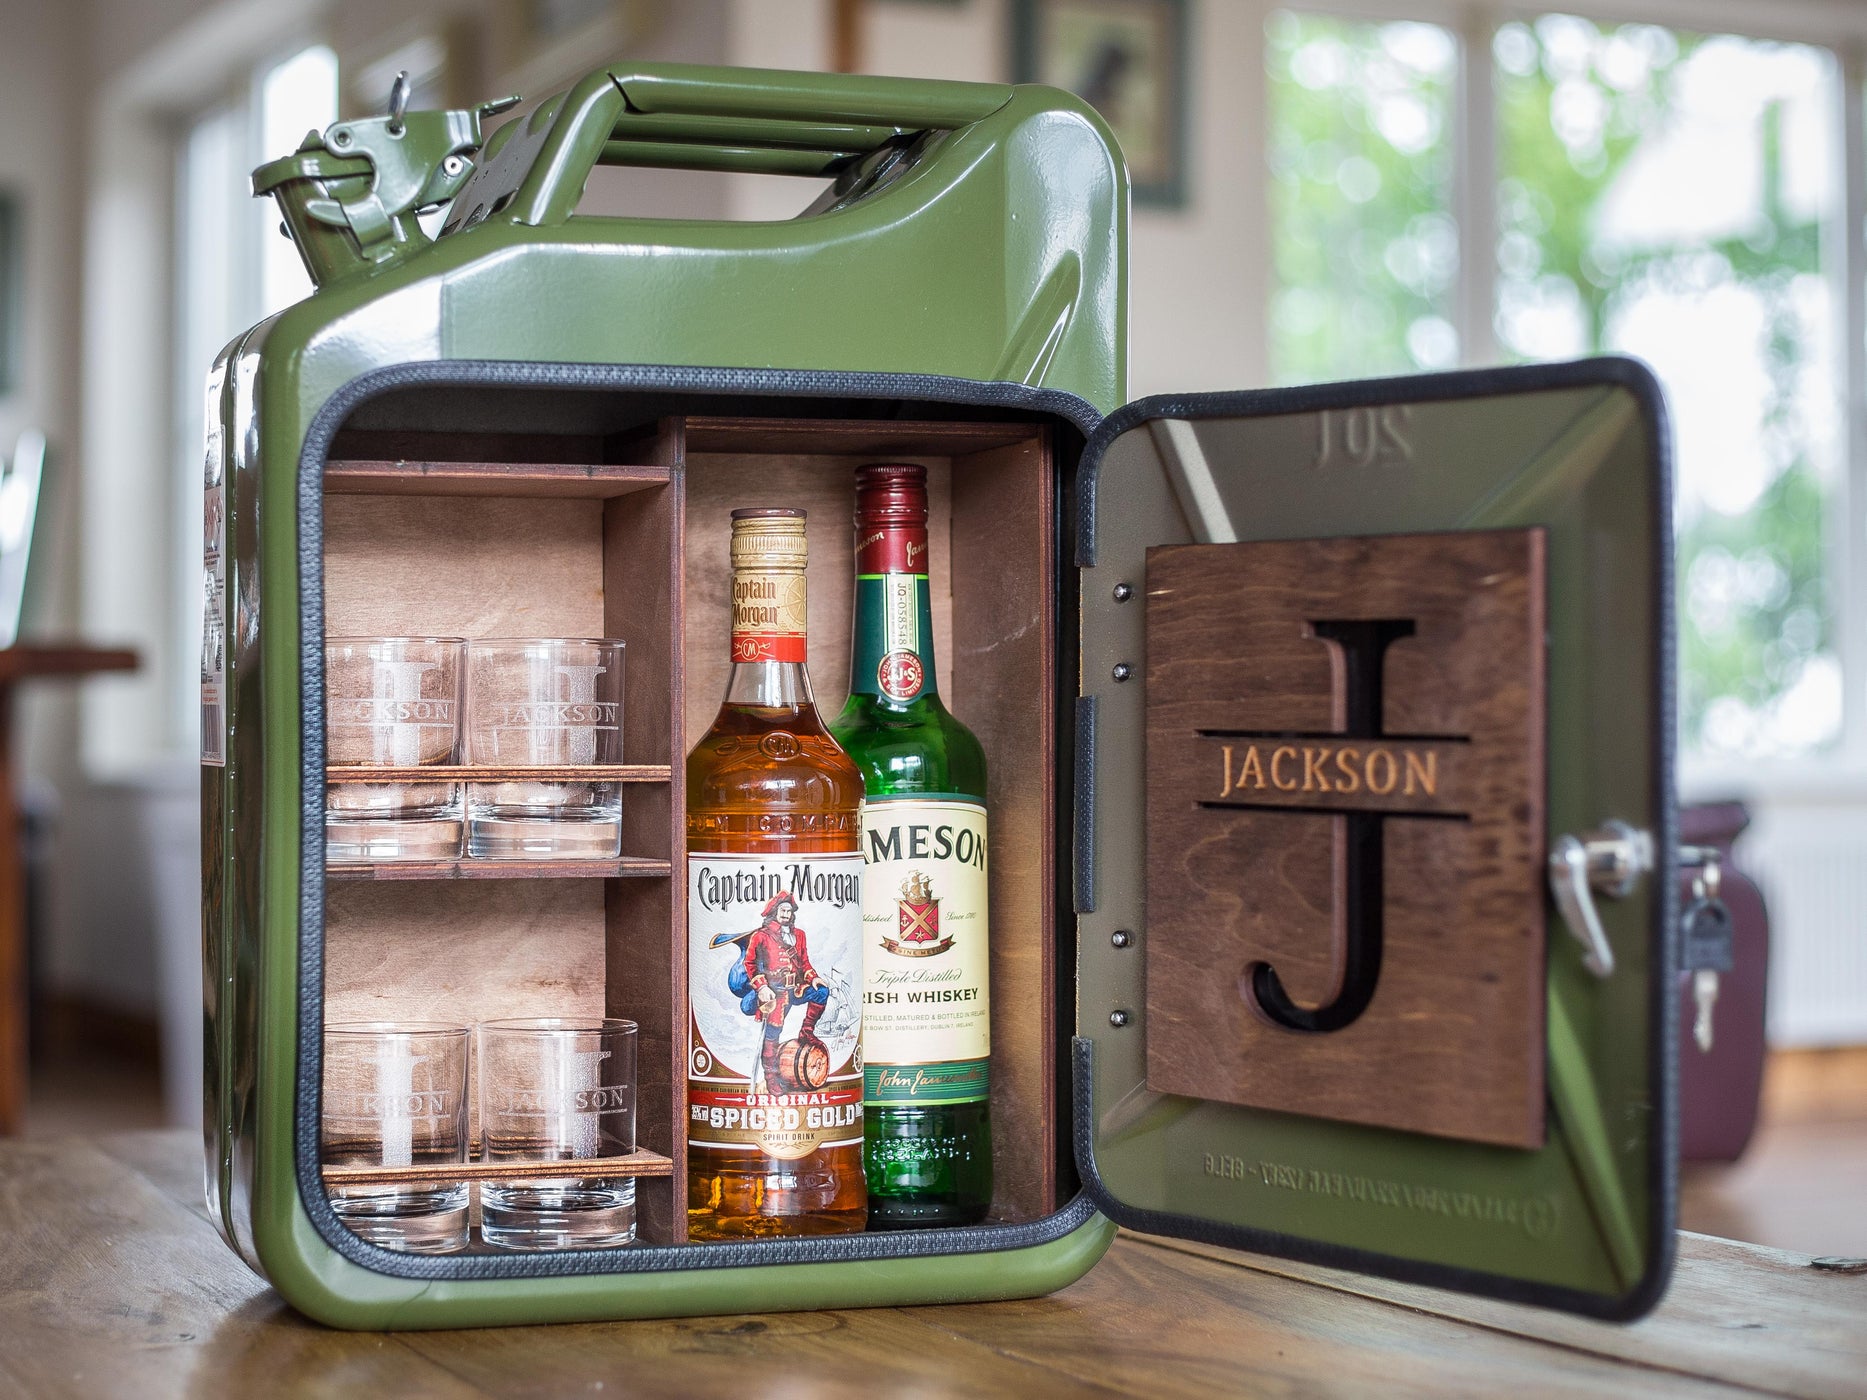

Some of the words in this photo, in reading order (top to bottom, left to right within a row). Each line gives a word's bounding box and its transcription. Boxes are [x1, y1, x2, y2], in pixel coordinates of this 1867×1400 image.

[732, 577, 776, 604] Captain
[731, 604, 777, 630] Morgan
[1219, 745, 1439, 798] JACKSON
[1240, 619, 1416, 1034] J
[697, 865, 783, 913] Captain
[784, 864, 861, 910] Morgan
[869, 969, 910, 988] Triple
[912, 967, 963, 983] Distilled
[907, 987, 979, 1004] WHISKEY
[937, 1012, 963, 1020] BOTTLED
[876, 1069, 912, 1096] John
[746, 1093, 830, 1107] ORIGINAL
[710, 1106, 800, 1131] SPICED
[806, 1104, 856, 1129] GOLD
[763, 1133, 788, 1141] SPIRIT
[792, 1132, 815, 1141] DRINK
